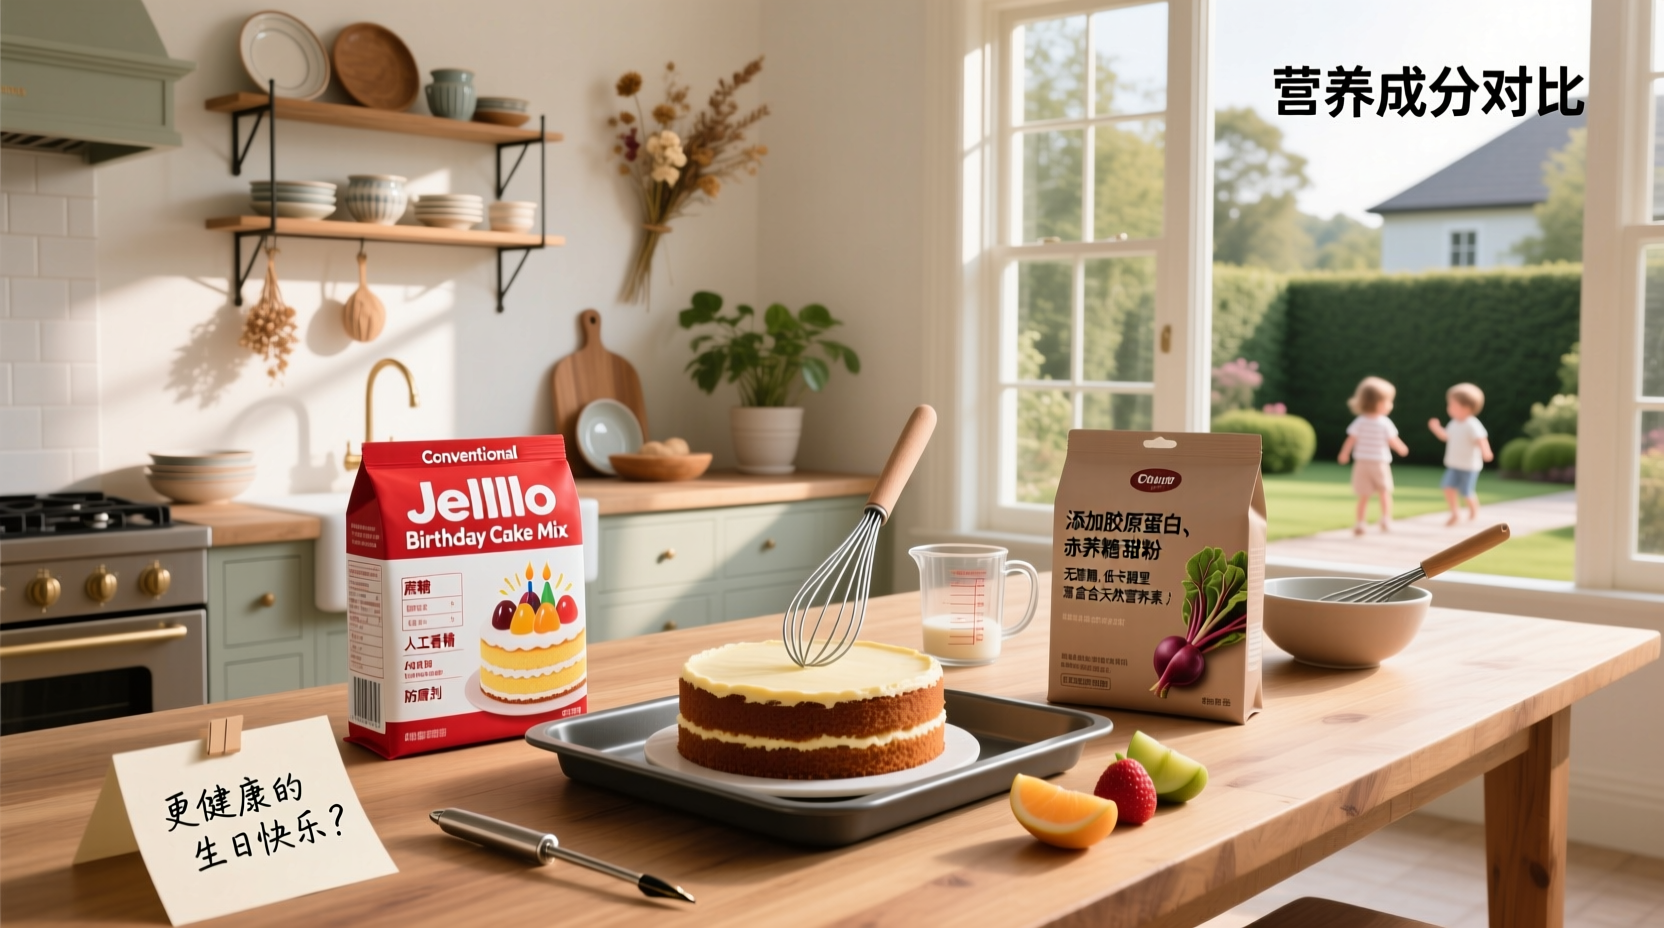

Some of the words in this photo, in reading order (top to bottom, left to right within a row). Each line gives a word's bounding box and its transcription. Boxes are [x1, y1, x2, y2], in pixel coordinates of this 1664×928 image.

[422, 445, 518, 464] Conventional
[406, 527, 486, 550] Birthday
[490, 524, 533, 544] Cake
[537, 520, 569, 540] Mix
[165, 773, 302, 832] 更健康的
[195, 803, 344, 872] 生日快乐?
